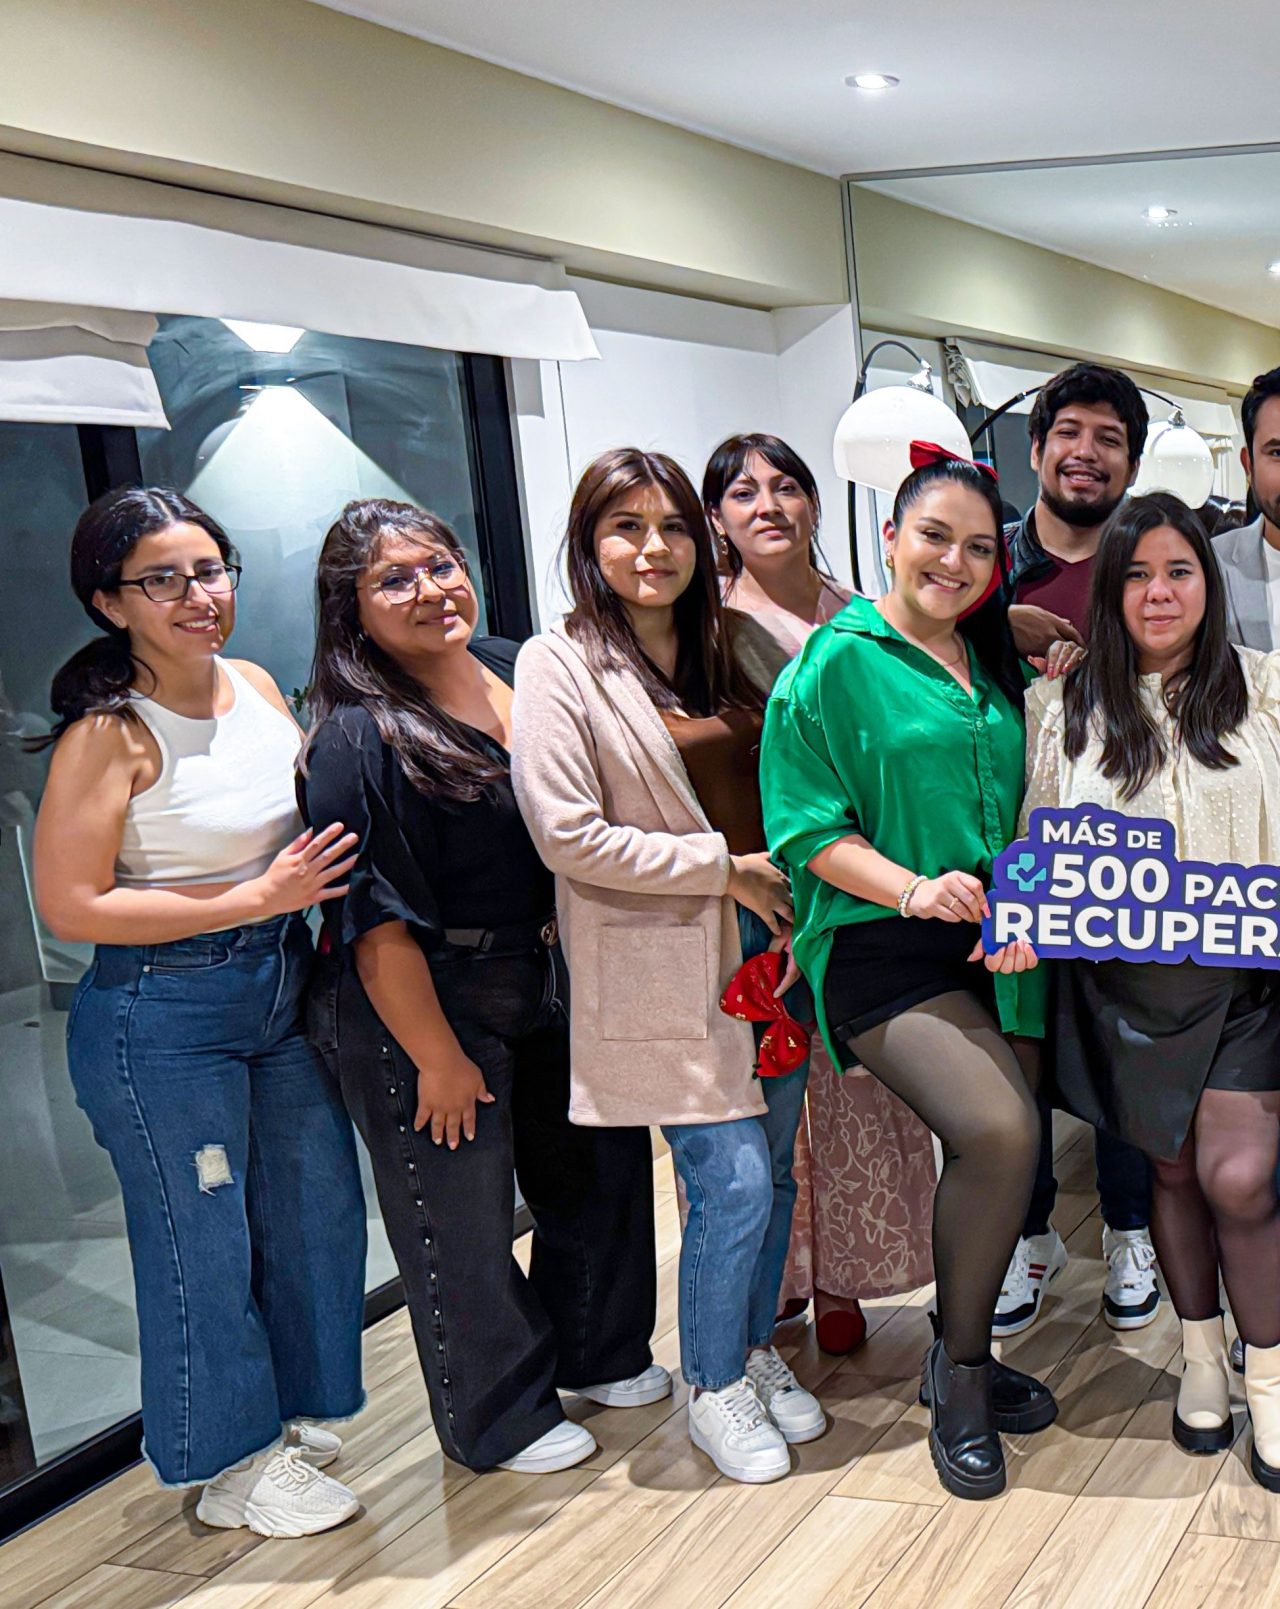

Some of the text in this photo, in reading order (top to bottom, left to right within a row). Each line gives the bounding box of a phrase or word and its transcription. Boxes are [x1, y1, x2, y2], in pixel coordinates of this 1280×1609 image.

[1042, 816, 1162, 850] MÁS DE
[1048, 853, 1170, 903] 500
